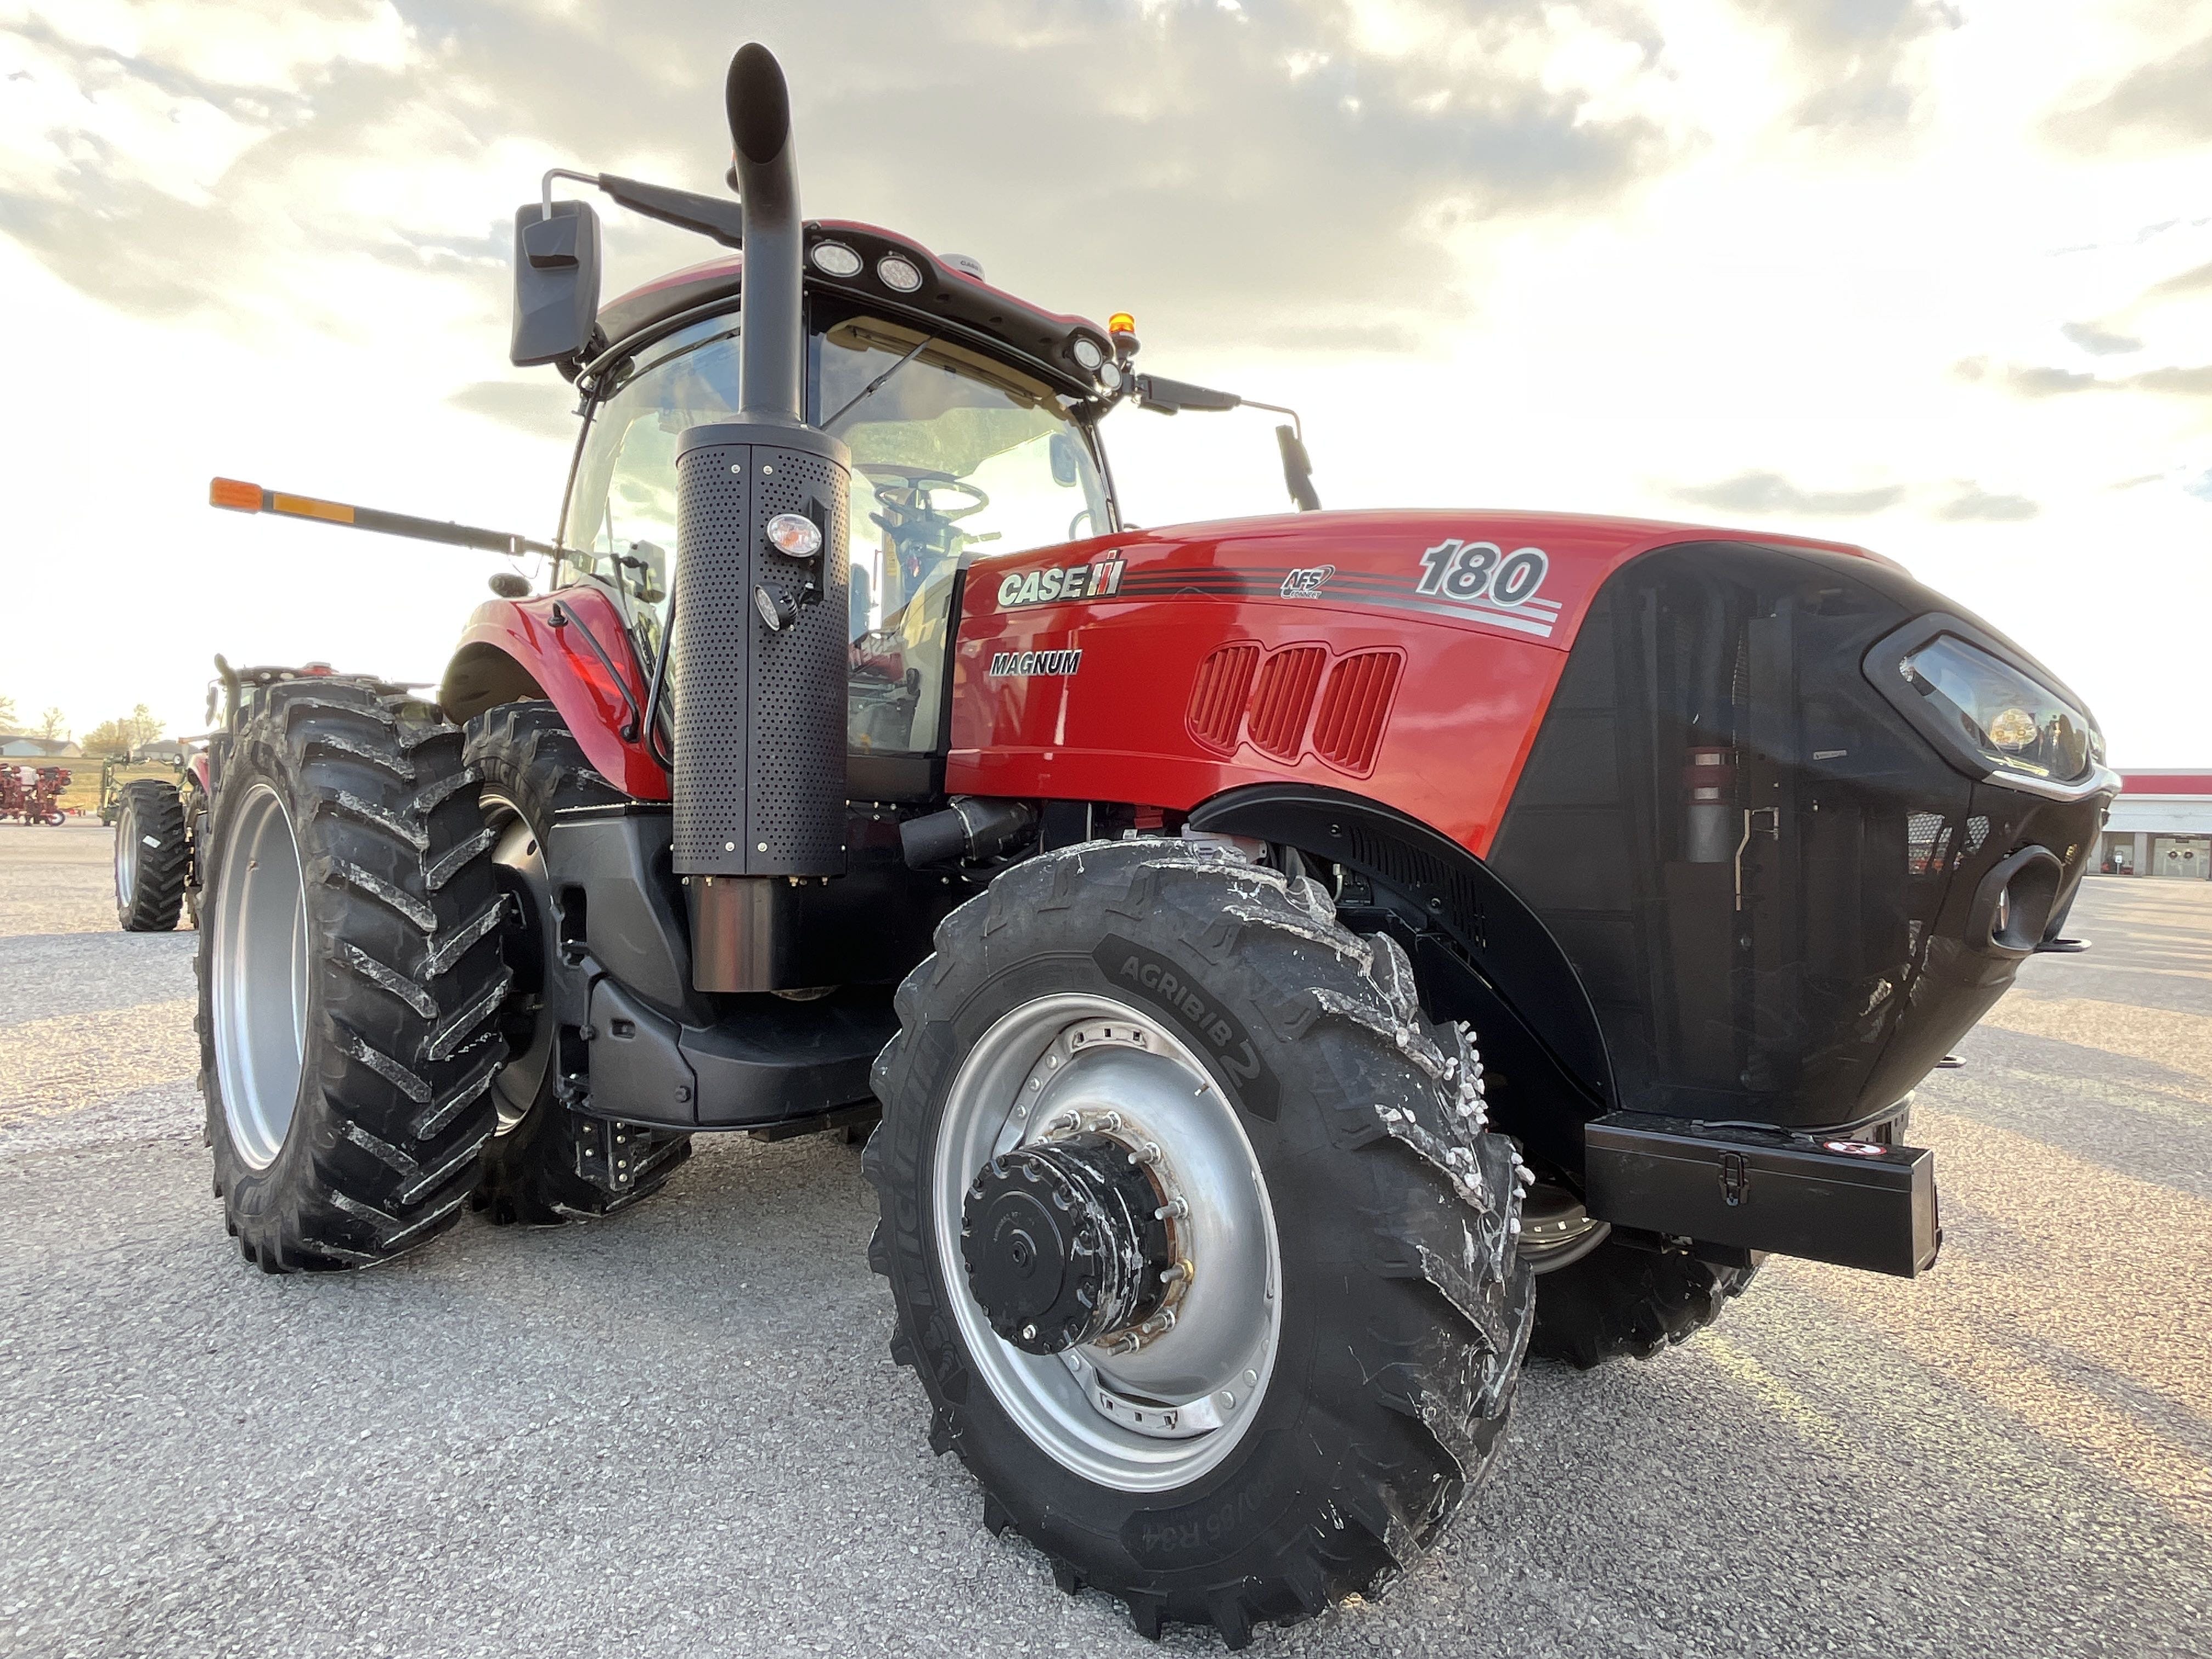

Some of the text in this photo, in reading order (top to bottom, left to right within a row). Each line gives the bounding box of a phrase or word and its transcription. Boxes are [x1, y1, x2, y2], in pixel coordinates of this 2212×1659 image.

[997, 565, 1089, 606] CASE
[1280, 568, 1325, 591] AFS
[1415, 538, 1548, 607] 180
[990, 649, 1083, 677] MAGNUM
[1120, 955, 1261, 1088] AGRIBIB 2
